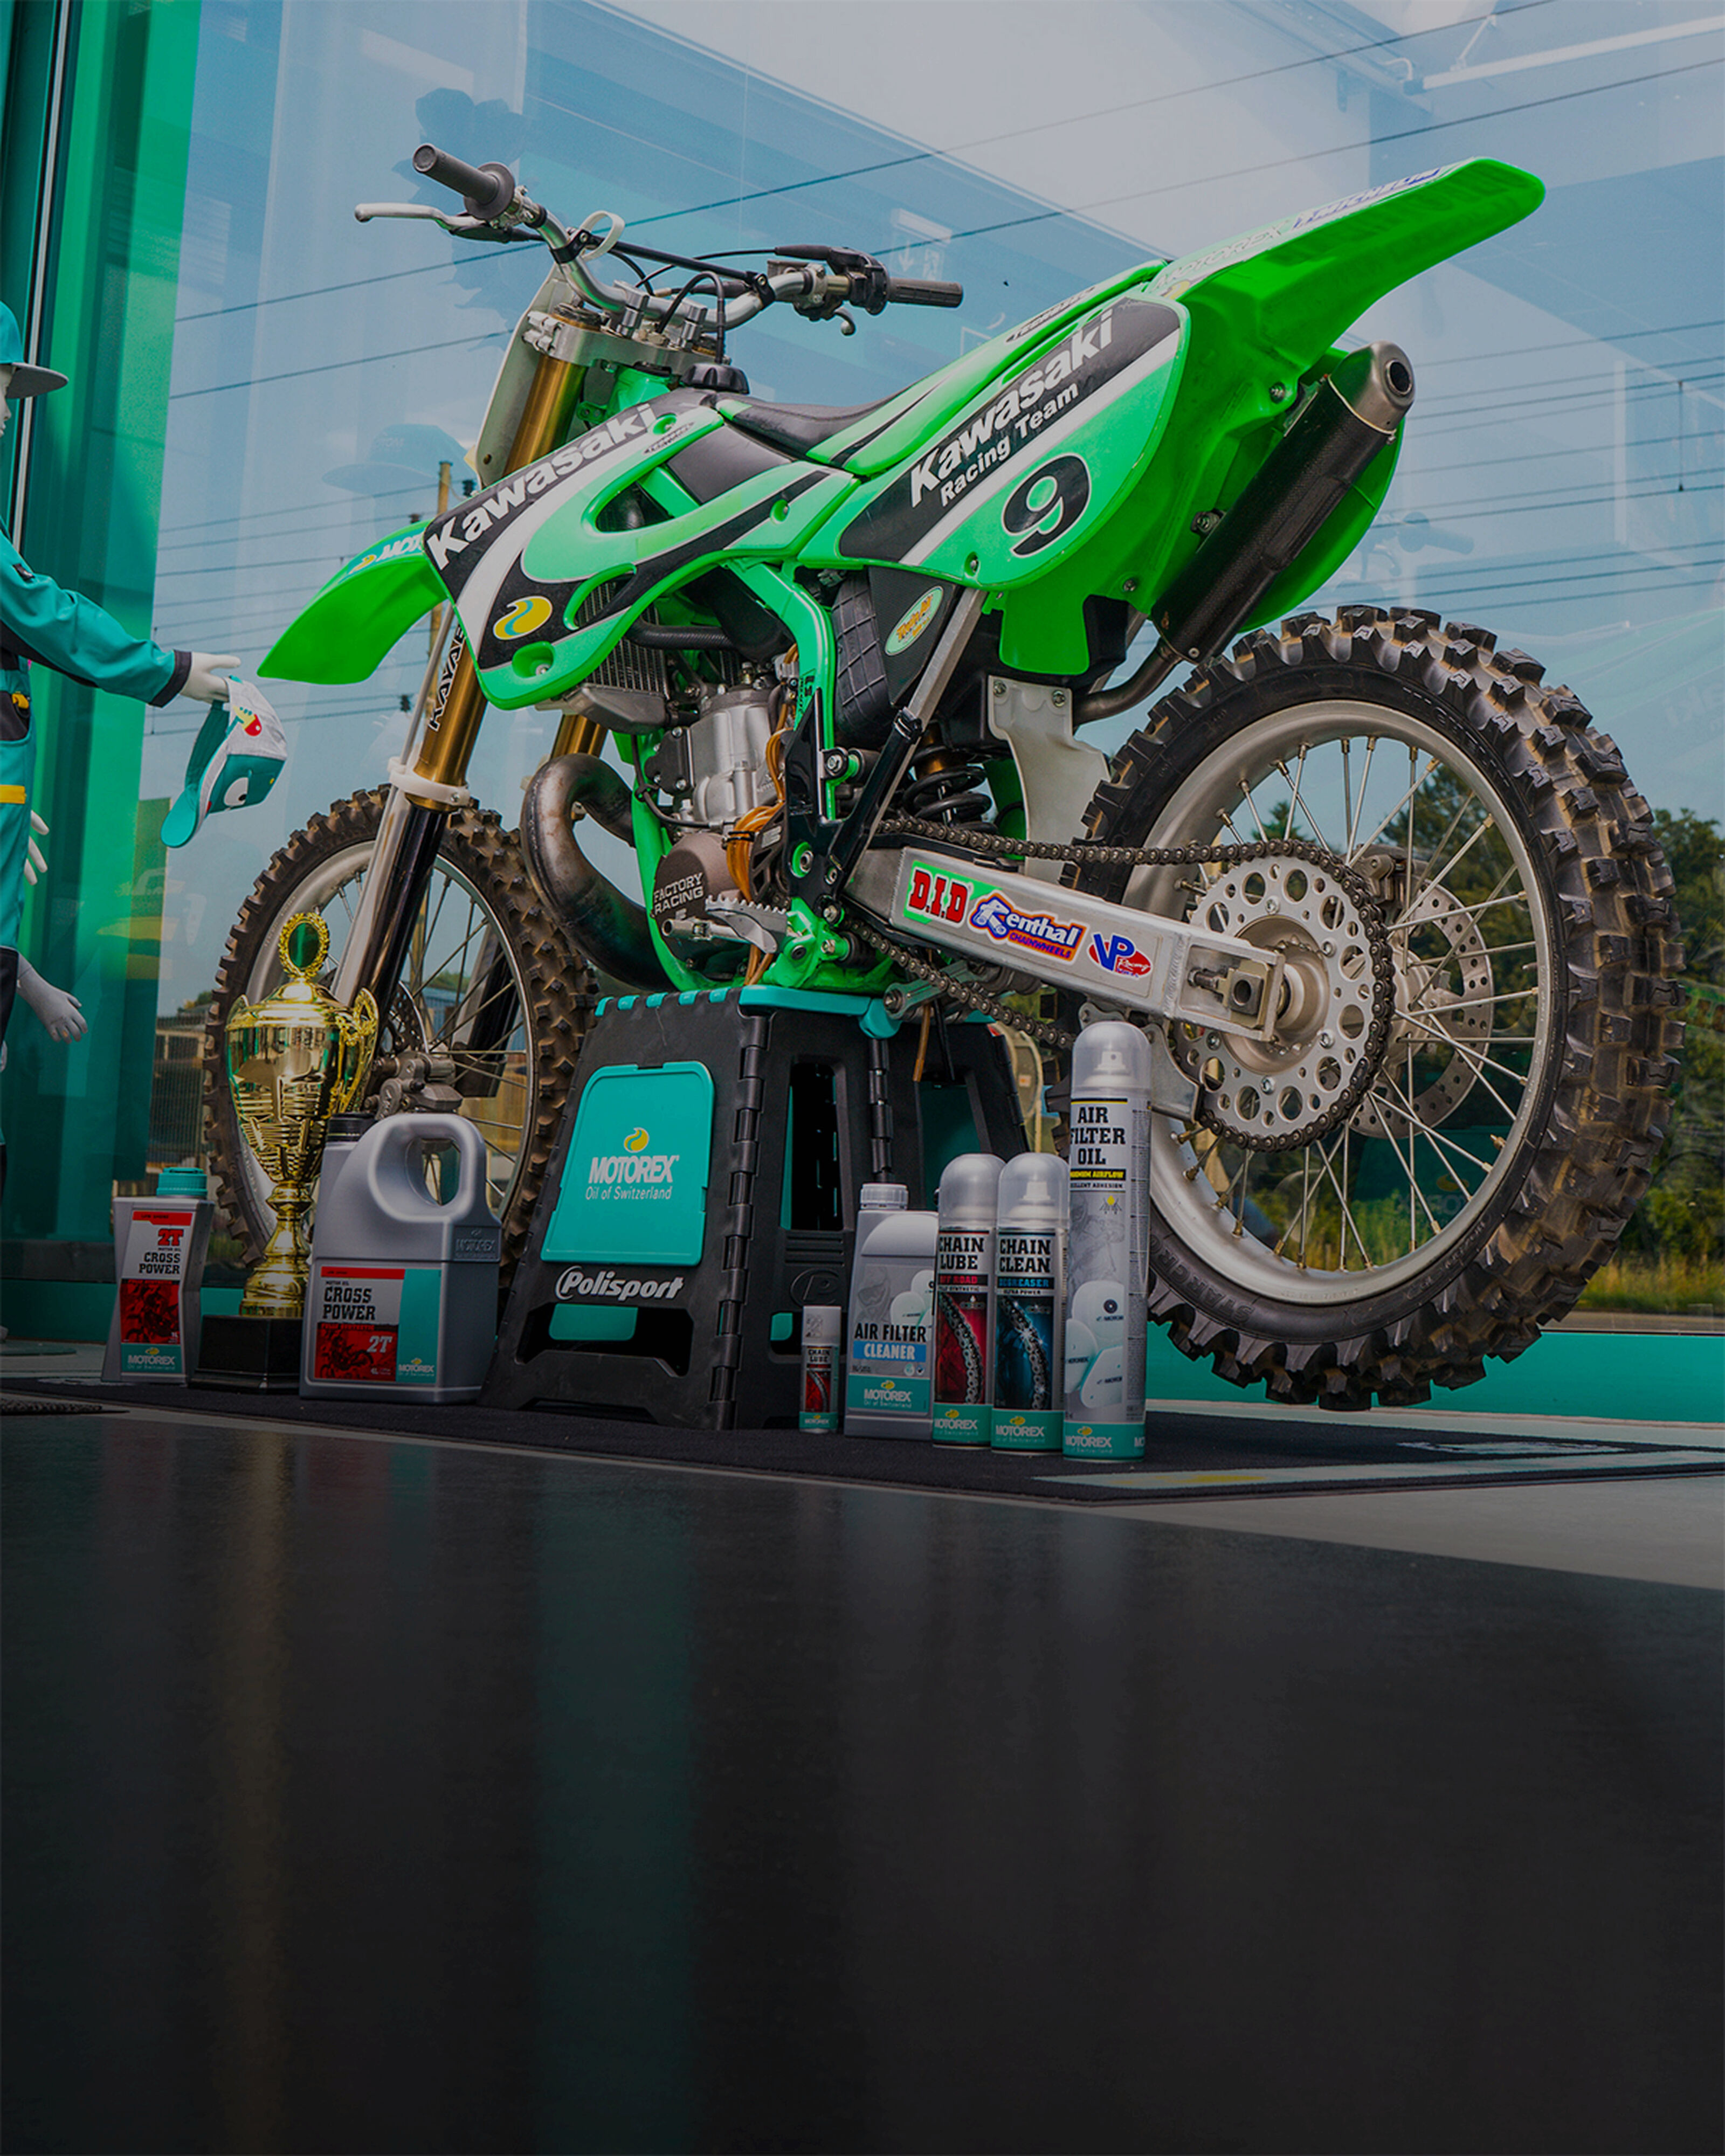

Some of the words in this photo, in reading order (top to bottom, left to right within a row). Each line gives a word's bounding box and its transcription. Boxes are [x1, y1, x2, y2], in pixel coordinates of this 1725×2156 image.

[1151, 218, 1291, 292] MOTOREX
[910, 309, 1113, 508] Kawasaki
[939, 437, 1011, 507] Racing
[1015, 383, 1079, 438] Team
[427, 404, 659, 571] Kawasaki
[1002, 452, 1092, 559] 9
[376, 530, 423, 563] MOT
[428, 624, 466, 732] KAYAB
[653, 872, 703, 903] FACTORY
[908, 868, 968, 924] D.I.D
[654, 886, 705, 916] RACING
[971, 896, 1082, 946] Renthal
[1009, 931, 1072, 959] CHAINWHEELS
[1093, 934, 1135, 972] VP
[1078, 1107, 1108, 1123] AIR
[1078, 1148, 1106, 1165] OIL
[588, 1155, 680, 1184] MOTOREX
[585, 1185, 599, 1200] Oil
[601, 1185, 613, 1200] of
[613, 1185, 673, 1200] Switzerland
[158, 1228, 184, 1247] 2T
[999, 1239, 1051, 1255] CHAIN
[144, 1252, 181, 1263] CROSS
[940, 1254, 978, 1269] LUBE
[999, 1257, 1050, 1273] CLEAN
[139, 1263, 180, 1275] POWER
[1149, 1234, 1255, 1323] STARCRO
[556, 1266, 685, 1302] Polisport
[953, 1275, 978, 1284] ROAD
[324, 1286, 372, 1304] CROSS
[322, 1304, 376, 1321] POWER
[854, 1323, 878, 1340] AIR
[882, 1324, 926, 1343] FILTER
[366, 1335, 393, 1354] 2T
[863, 1342, 916, 1360] CLEANER
[128, 1355, 175, 1365] MOTOREX
[398, 1363, 436, 1373] MOTOREX
[864, 1387, 913, 1402] MOTOREX
[934, 1418, 979, 1431] MOTOREX
[995, 1425, 1045, 1438] MOTOREX
[1065, 1435, 1113, 1448] MOTOREX
